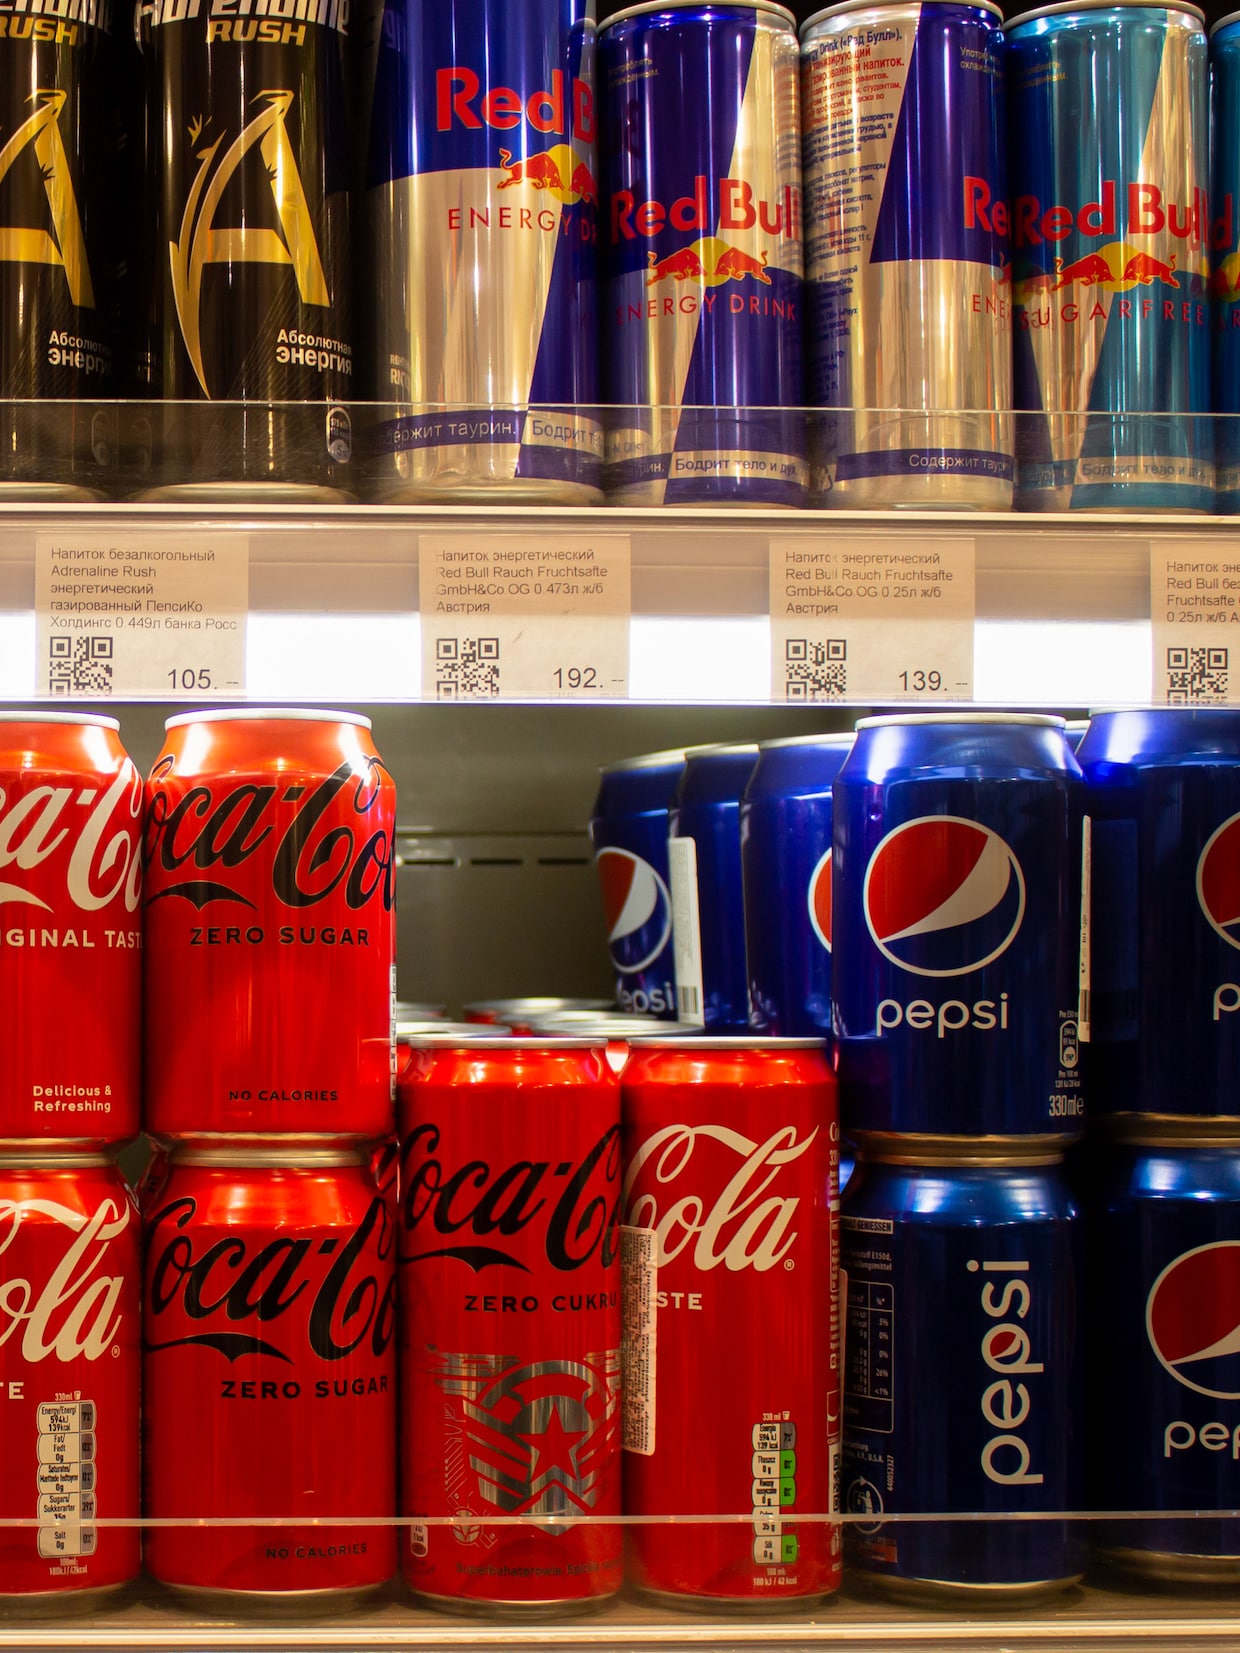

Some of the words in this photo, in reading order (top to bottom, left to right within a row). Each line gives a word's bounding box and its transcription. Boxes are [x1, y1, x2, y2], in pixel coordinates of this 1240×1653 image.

[205, 20, 307, 46] RUSH
[436, 67, 564, 134] Red
[611, 176, 707, 244] Red
[719, 179, 802, 243] Bull
[1016, 180, 1115, 247] Red
[1128, 183, 1208, 244] Bull
[449, 207, 571, 236] ENERGY
[617, 295, 716, 325] ENERGY
[730, 294, 796, 322] DRINK
[1021, 300, 1204, 331] SUGARFREE
[277, 328, 352, 357] Абсолютная
[276, 346, 352, 376] энергия
[448, 421, 517, 440] таурин.
[533, 420, 585, 442] Бодрит
[676, 458, 730, 473] Бодрит
[734, 460, 766, 471] тело
[909, 454, 980, 470] Содержит
[51, 548, 105, 560] Напиток
[110, 548, 215, 561] безалкогольный
[492, 549, 594, 563] энергетический
[841, 553, 940, 566] энергетический
[50, 565, 119, 577] Adrenaline
[122, 566, 157, 578] Rush
[436, 567, 461, 578] Red
[465, 567, 489, 578] Bull
[492, 566, 534, 578] Rauch
[537, 566, 608, 577] Fruchtsafte
[1167, 562, 1218, 573] Напиток
[786, 569, 811, 580] Red
[815, 569, 838, 580] Bull
[842, 569, 881, 581] Rauch
[885, 570, 953, 581] Fruchtsafte
[50, 583, 154, 596] энергетический
[582, 582, 604, 594] ж/б
[1167, 578, 1192, 589] Red
[1196, 578, 1219, 589] Bull
[920, 586, 941, 598] ж/б
[50, 600, 142, 613] газированный
[146, 600, 203, 612] ПепсиКо
[1167, 594, 1235, 606] Fruchtsafte
[436, 601, 490, 615] Австрия
[786, 603, 838, 616] Австрия
[50, 616, 112, 629] Холдингс
[164, 617, 201, 629] банка
[205, 618, 237, 630] Росс
[191, 928, 264, 945] ZERO
[279, 928, 369, 946] SUGAR
[876, 993, 1008, 1038] pepsi
[33, 1086, 100, 1096] Delicious
[229, 1091, 252, 1100] NO
[258, 1090, 338, 1101] CALORIES
[34, 1100, 111, 1113] Refreshing
[465, 1296, 539, 1312] ZERO
[552, 1294, 617, 1312] CUKRU
[966, 1259, 1044, 1486] pepsi
[221, 1381, 300, 1399] ZERO
[315, 1375, 388, 1398] SUGAR
